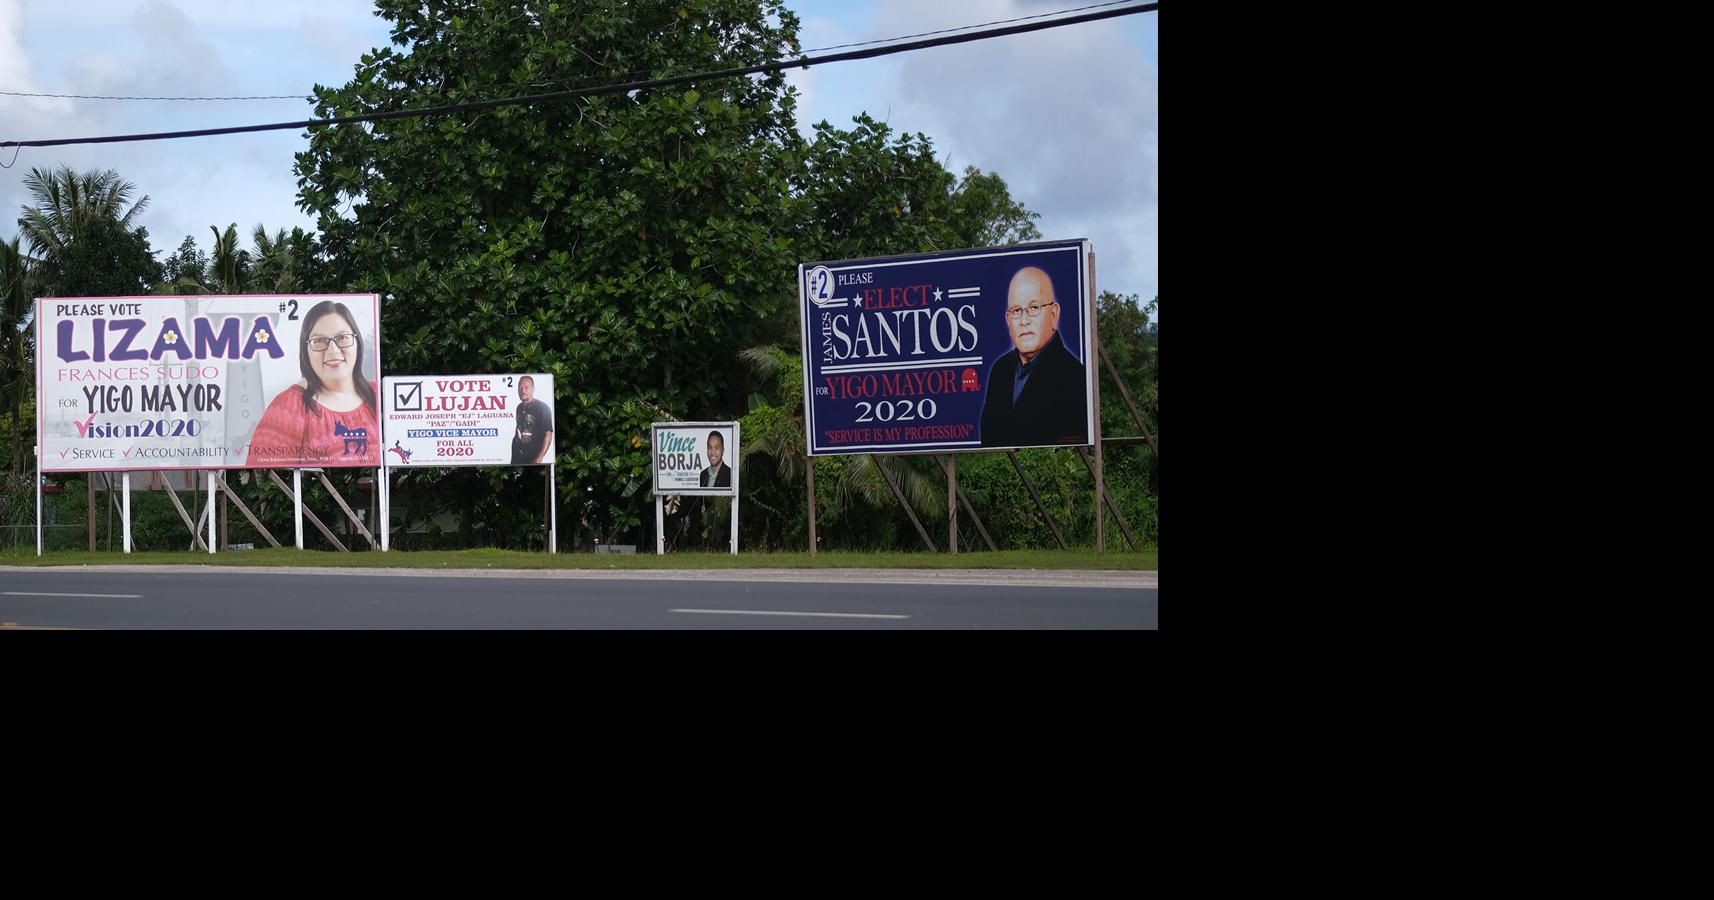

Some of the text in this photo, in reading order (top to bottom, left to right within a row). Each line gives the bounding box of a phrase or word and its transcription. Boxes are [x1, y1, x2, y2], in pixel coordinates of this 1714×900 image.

[810, 270, 828, 299] #2
[838, 272, 873, 286] PLEASE
[864, 284, 932, 310] ELECT
[56, 303, 141, 317] PLEASE VOTE
[279, 300, 299, 321] #2
[56, 315, 285, 363] LIZAMA
[823, 312, 832, 364] JAMES
[832, 305, 978, 360] SANTOS
[58, 366, 218, 382] FRANCES SUDO
[815, 369, 957, 400] FOR YIGO MAYOR
[435, 380, 491, 392] VOTE
[58, 383, 222, 414] FOR YIGO MAYOR
[425, 395, 507, 411] LUJAN
[855, 398, 937, 423] 2020
[659, 432, 696, 453] Vince
[825, 424, 973, 443] "SERVICE IS MY PROFESSION"
[437, 448, 474, 456] 2020
[659, 453, 702, 470] BORJA
